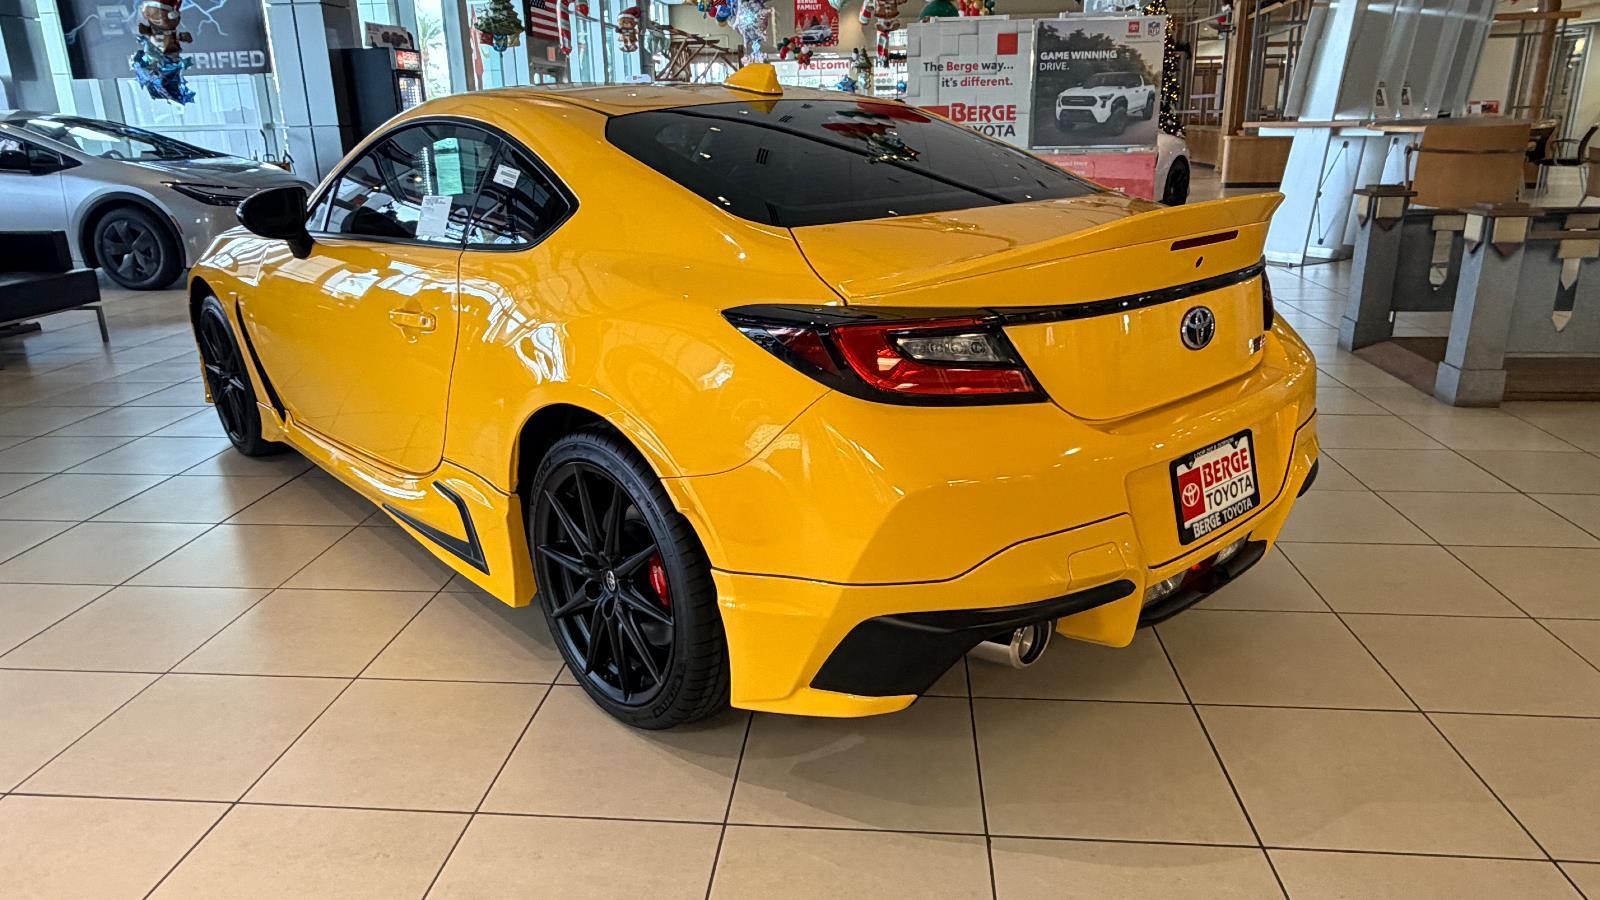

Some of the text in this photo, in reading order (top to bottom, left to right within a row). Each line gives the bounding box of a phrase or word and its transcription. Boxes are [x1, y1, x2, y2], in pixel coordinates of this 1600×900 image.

[1040, 50, 1118, 60] GAME WINNING
[923, 61, 1014, 73] The Berge way...
[1040, 62, 1070, 71] DRIVE.
[942, 77, 1014, 88] it's different.
[951, 102, 1017, 123] BERGE
[973, 124, 1016, 137] YOTA
[1202, 448, 1249, 489] BERGE
[1205, 474, 1253, 510] TOYOTA
[1193, 497, 1253, 538] BERGE TOYOTA
